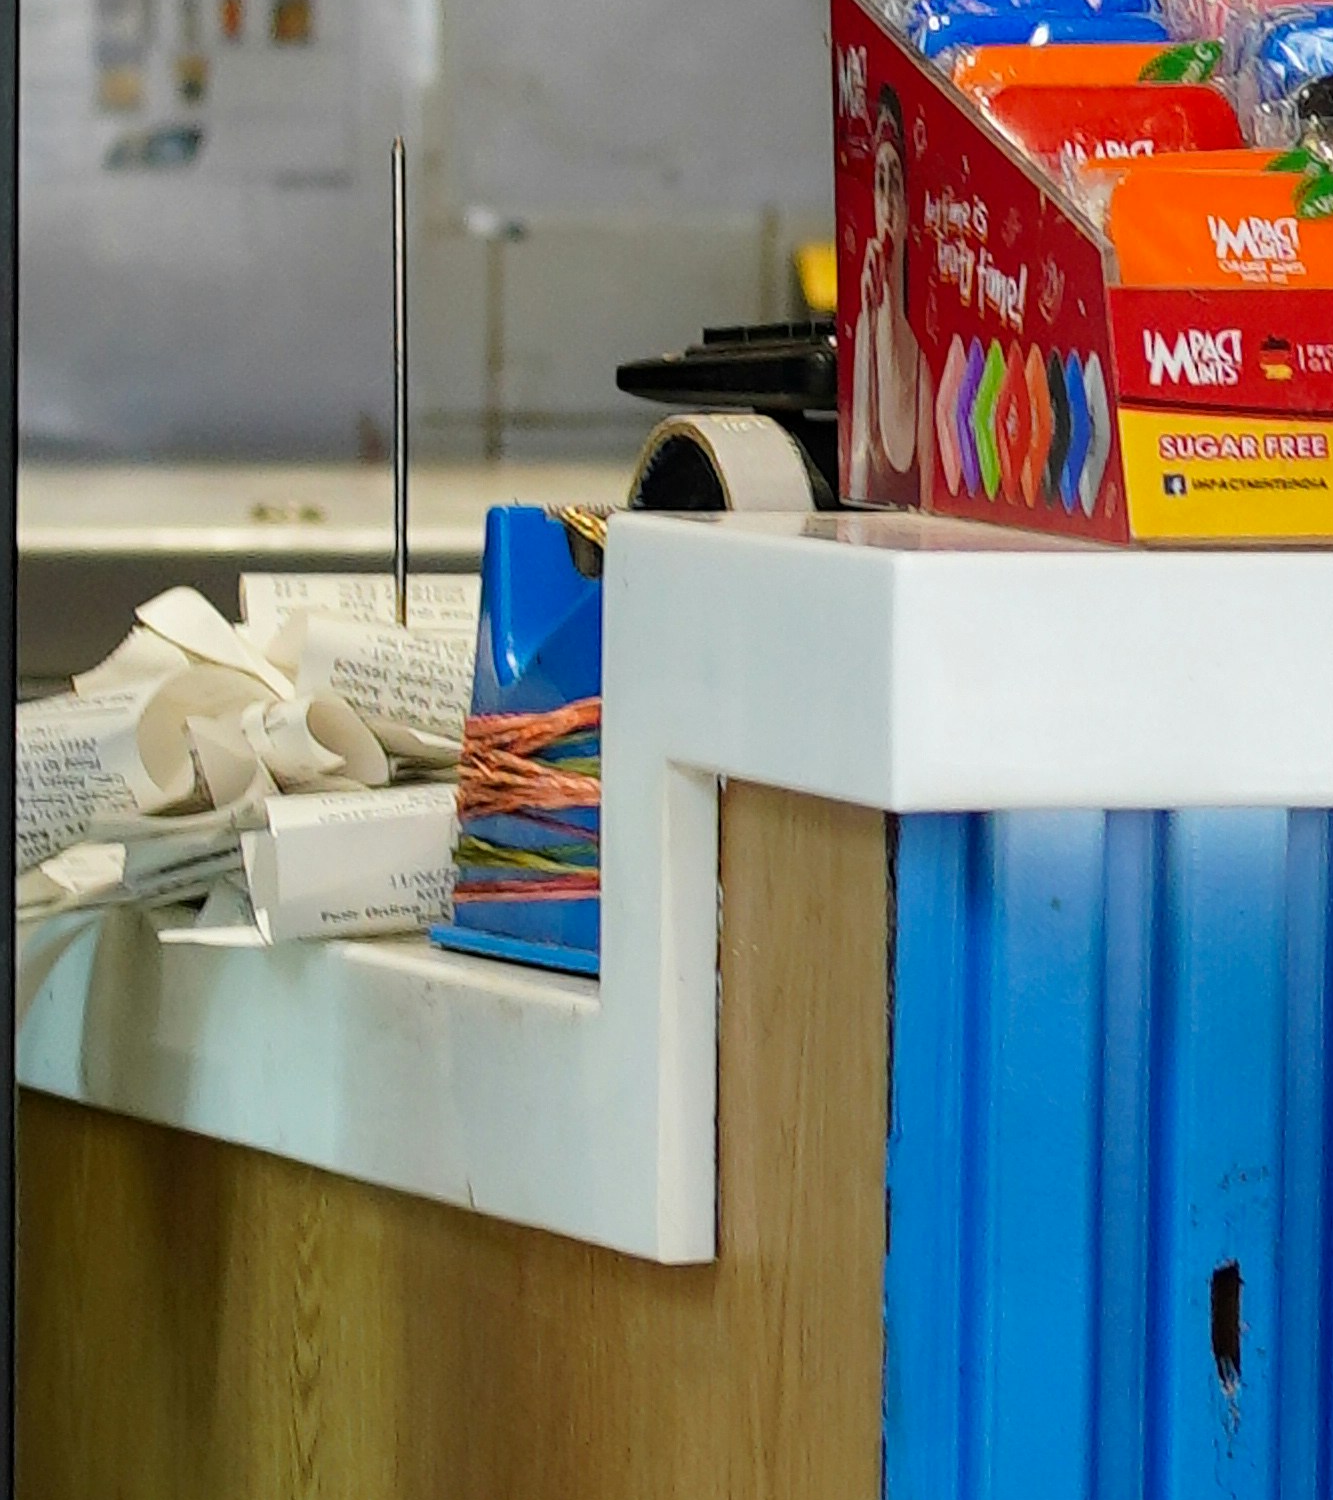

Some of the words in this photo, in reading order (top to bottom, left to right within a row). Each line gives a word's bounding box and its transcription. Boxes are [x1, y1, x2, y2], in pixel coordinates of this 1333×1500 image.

[1143, 328, 1243, 386] IMPACT
[1159, 433, 1259, 459] SUGAR
[1264, 433, 1329, 458] FREE
